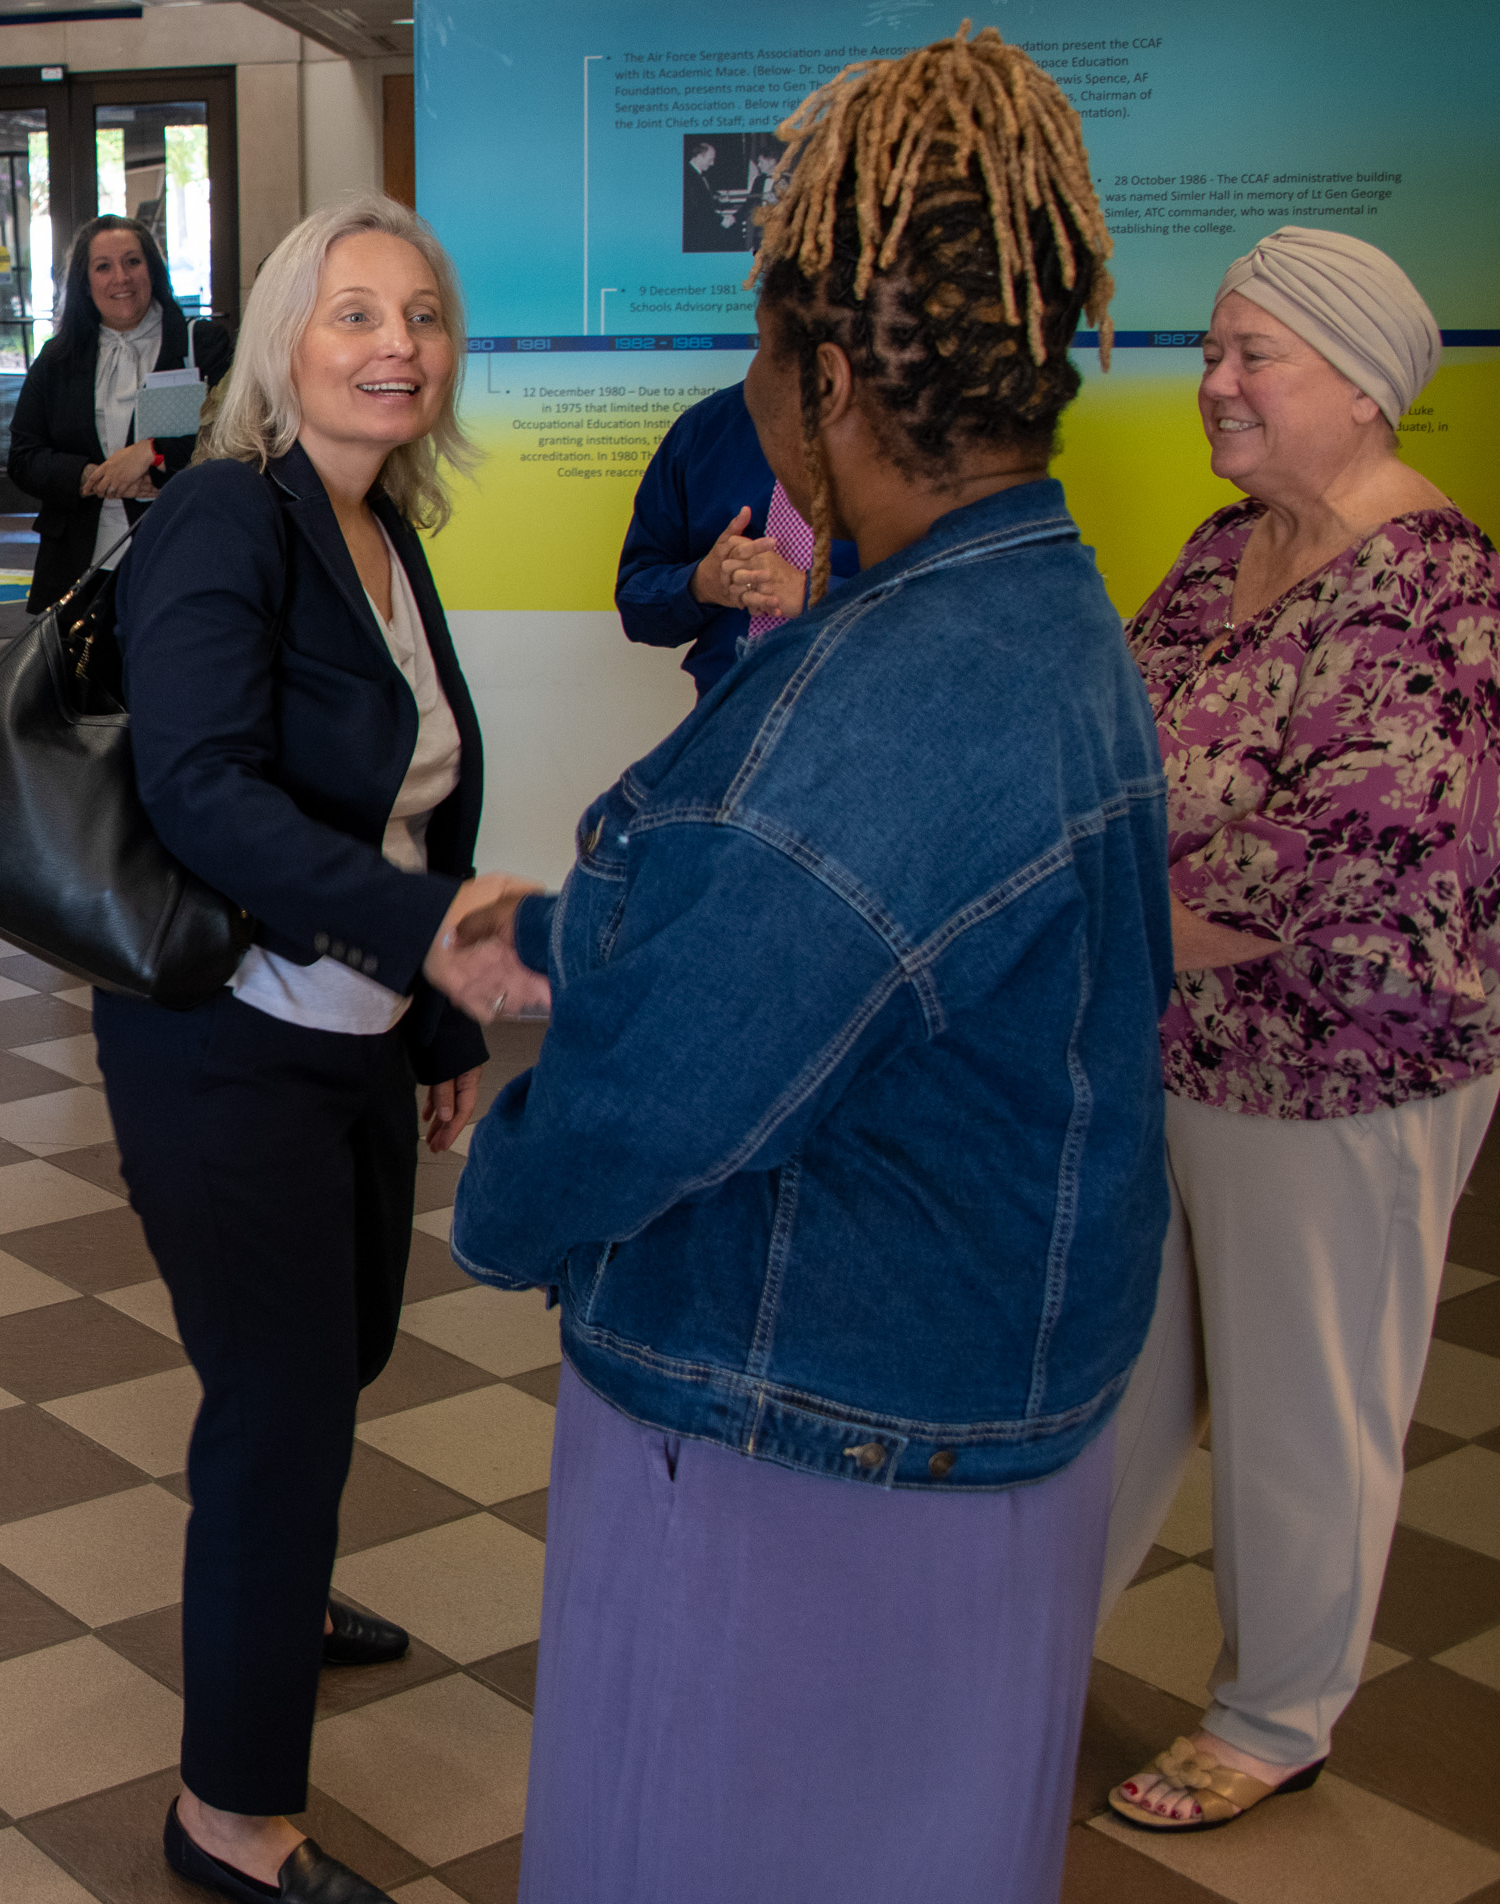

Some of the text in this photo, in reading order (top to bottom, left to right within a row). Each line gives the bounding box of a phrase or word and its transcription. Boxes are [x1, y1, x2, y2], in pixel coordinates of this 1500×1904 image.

[1062, 40, 1106, 53] present
[1110, 38, 1129, 49] the
[1132, 38, 1163, 49] CCAF
[624, 53, 643, 63] The
[647, 52, 663, 62] Air
[666, 51, 696, 62] Force
[700, 49, 754, 63] Sergeants
[757, 47, 821, 60] Association
[824, 46, 845, 57] and
[849, 46, 867, 56] the
[1036, 57, 1129, 70] space Education
[615, 63, 841, 80] with its Academic Mace. (Below- Dr. Don
[1052, 73, 1149, 86] ewis Spence, AF
[615, 85, 681, 98] Foundation,
[684, 83, 732, 97] presents
[735, 84, 766, 94] mace
[768, 82, 780, 92] to
[783, 81, 806, 92] Gen
[1081, 89, 1136, 101] Chairman
[1140, 89, 1153, 100] of
[615, 101, 669, 115] Sergeants
[671, 100, 735, 112] Association
[745, 98, 779, 110] Below
[615, 118, 633, 130] the
[636, 117, 662, 129] Joint
[665, 115, 699, 128] Chiefs
[702, 115, 714, 127] of
[716, 114, 746, 127] Staff;
[749, 114, 772, 126] and
[1114, 175, 1128, 186] 28
[1131, 174, 1176, 186] October
[1179, 174, 1207, 185] 1986
[1217, 174, 1238, 184] The
[1241, 173, 1270, 184] CCAF
[1273, 172, 1353, 184] administrative
[1356, 172, 1402, 185] building
[1105, 187, 1392, 203] was named Simler Hall in memory of Lt Gen George
[1105, 205, 1378, 219] Simler, ATC commander, who was instrumental in
[1172, 222, 1191, 234] the
[1193, 222, 1236, 236] college.
[639, 285, 738, 296] 9 December 1981
[630, 302, 672, 313] Schools
[675, 301, 722, 314] Advisory
[468, 339, 495, 351] 80
[516, 338, 551, 351] 1981
[614, 337, 656, 350] 1982
[672, 336, 713, 349] 1985
[1153, 333, 1199, 346] 1987
[523, 388, 536, 397] 12
[539, 387, 596, 398] December
[599, 387, 626, 397] 1980
[639, 386, 661, 397] Due
[663, 387, 675, 397] to
[678, 389, 685, 397] a
[542, 403, 553, 413] in
[555, 403, 583, 413] 1975
[585, 402, 607, 413] that
[610, 402, 649, 413] limited
[651, 402, 670, 413] the
[512, 419, 673, 432] Occupational Education Instit
[1396, 421, 1448, 434] duate), in
[538, 435, 583, 448] granting
[586, 434, 650, 448] institutions,
[520, 451, 593, 462] accreditation.
[597, 451, 607, 461] In
[611, 451, 638, 462] 1980
[557, 466, 602, 479] Colleges
